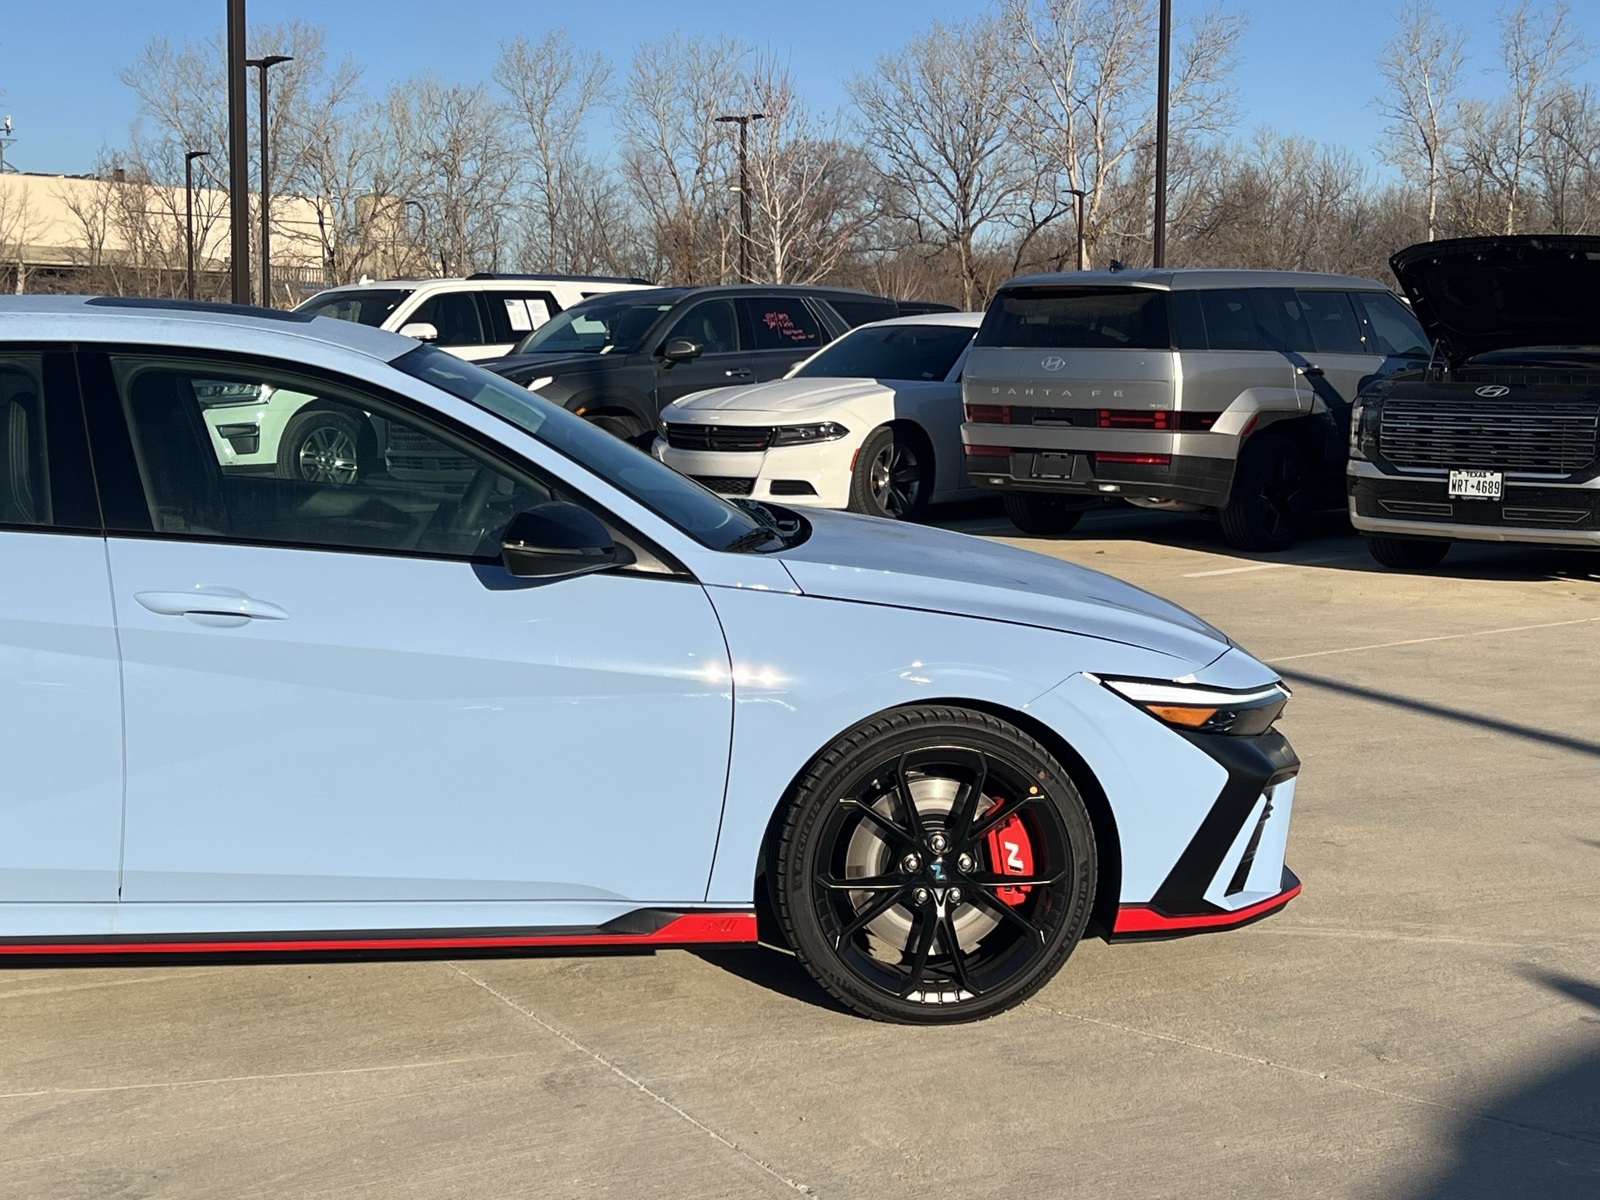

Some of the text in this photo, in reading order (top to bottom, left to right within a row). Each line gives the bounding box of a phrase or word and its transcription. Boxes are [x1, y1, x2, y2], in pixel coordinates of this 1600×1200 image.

[991, 387, 1124, 398] SANTA FE
[794, 802, 821, 869] MICHELIN
[1062, 881, 1089, 948] MICHELIN
